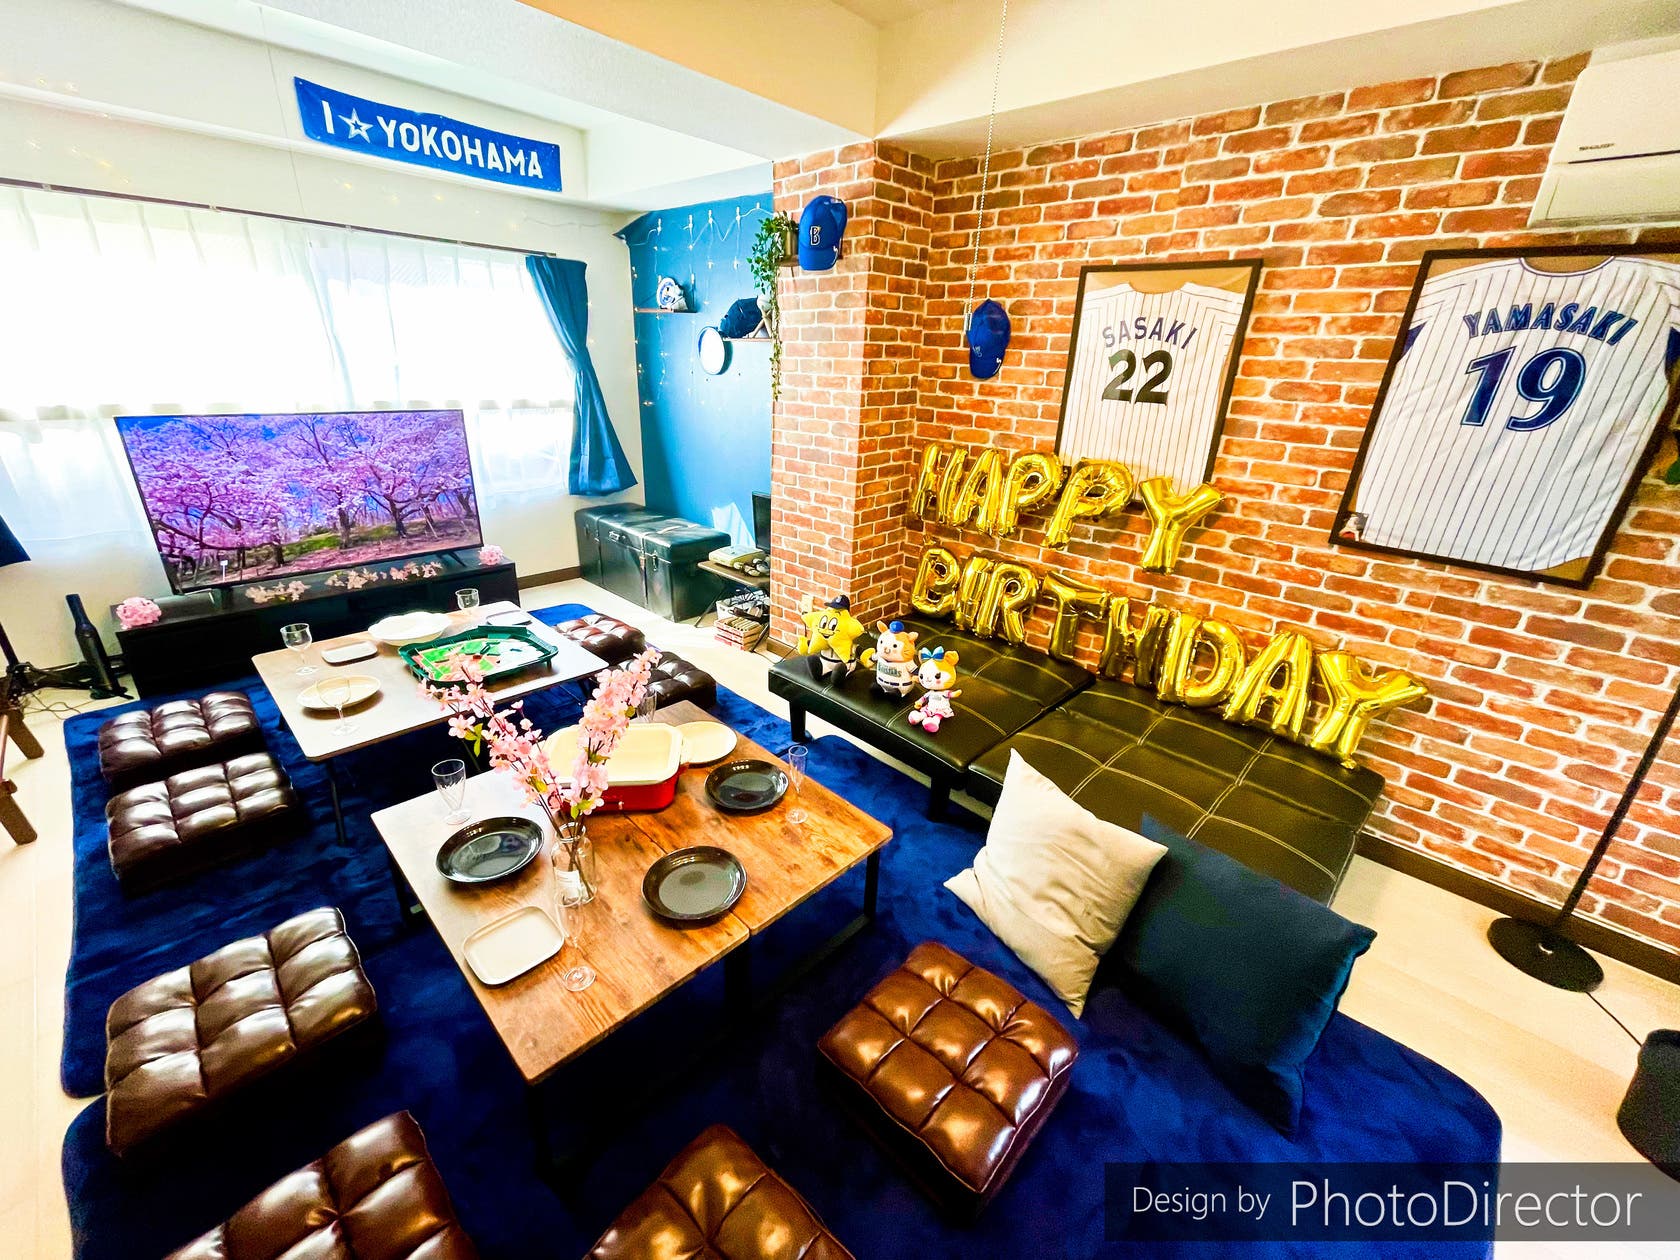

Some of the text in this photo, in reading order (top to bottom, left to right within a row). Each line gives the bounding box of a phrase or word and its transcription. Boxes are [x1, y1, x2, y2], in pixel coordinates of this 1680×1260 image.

[321, 100, 544, 179] I YOKOHAMA
[809, 226, 821, 246] B
[1102, 316, 1197, 350] SASAKI
[1462, 302, 1638, 347] YAMASAKI
[1101, 349, 1173, 406] 22
[1460, 345, 1587, 432] 19
[912, 442, 1226, 574] HAPPY
[911, 546, 1429, 769] BIRTHDAY
